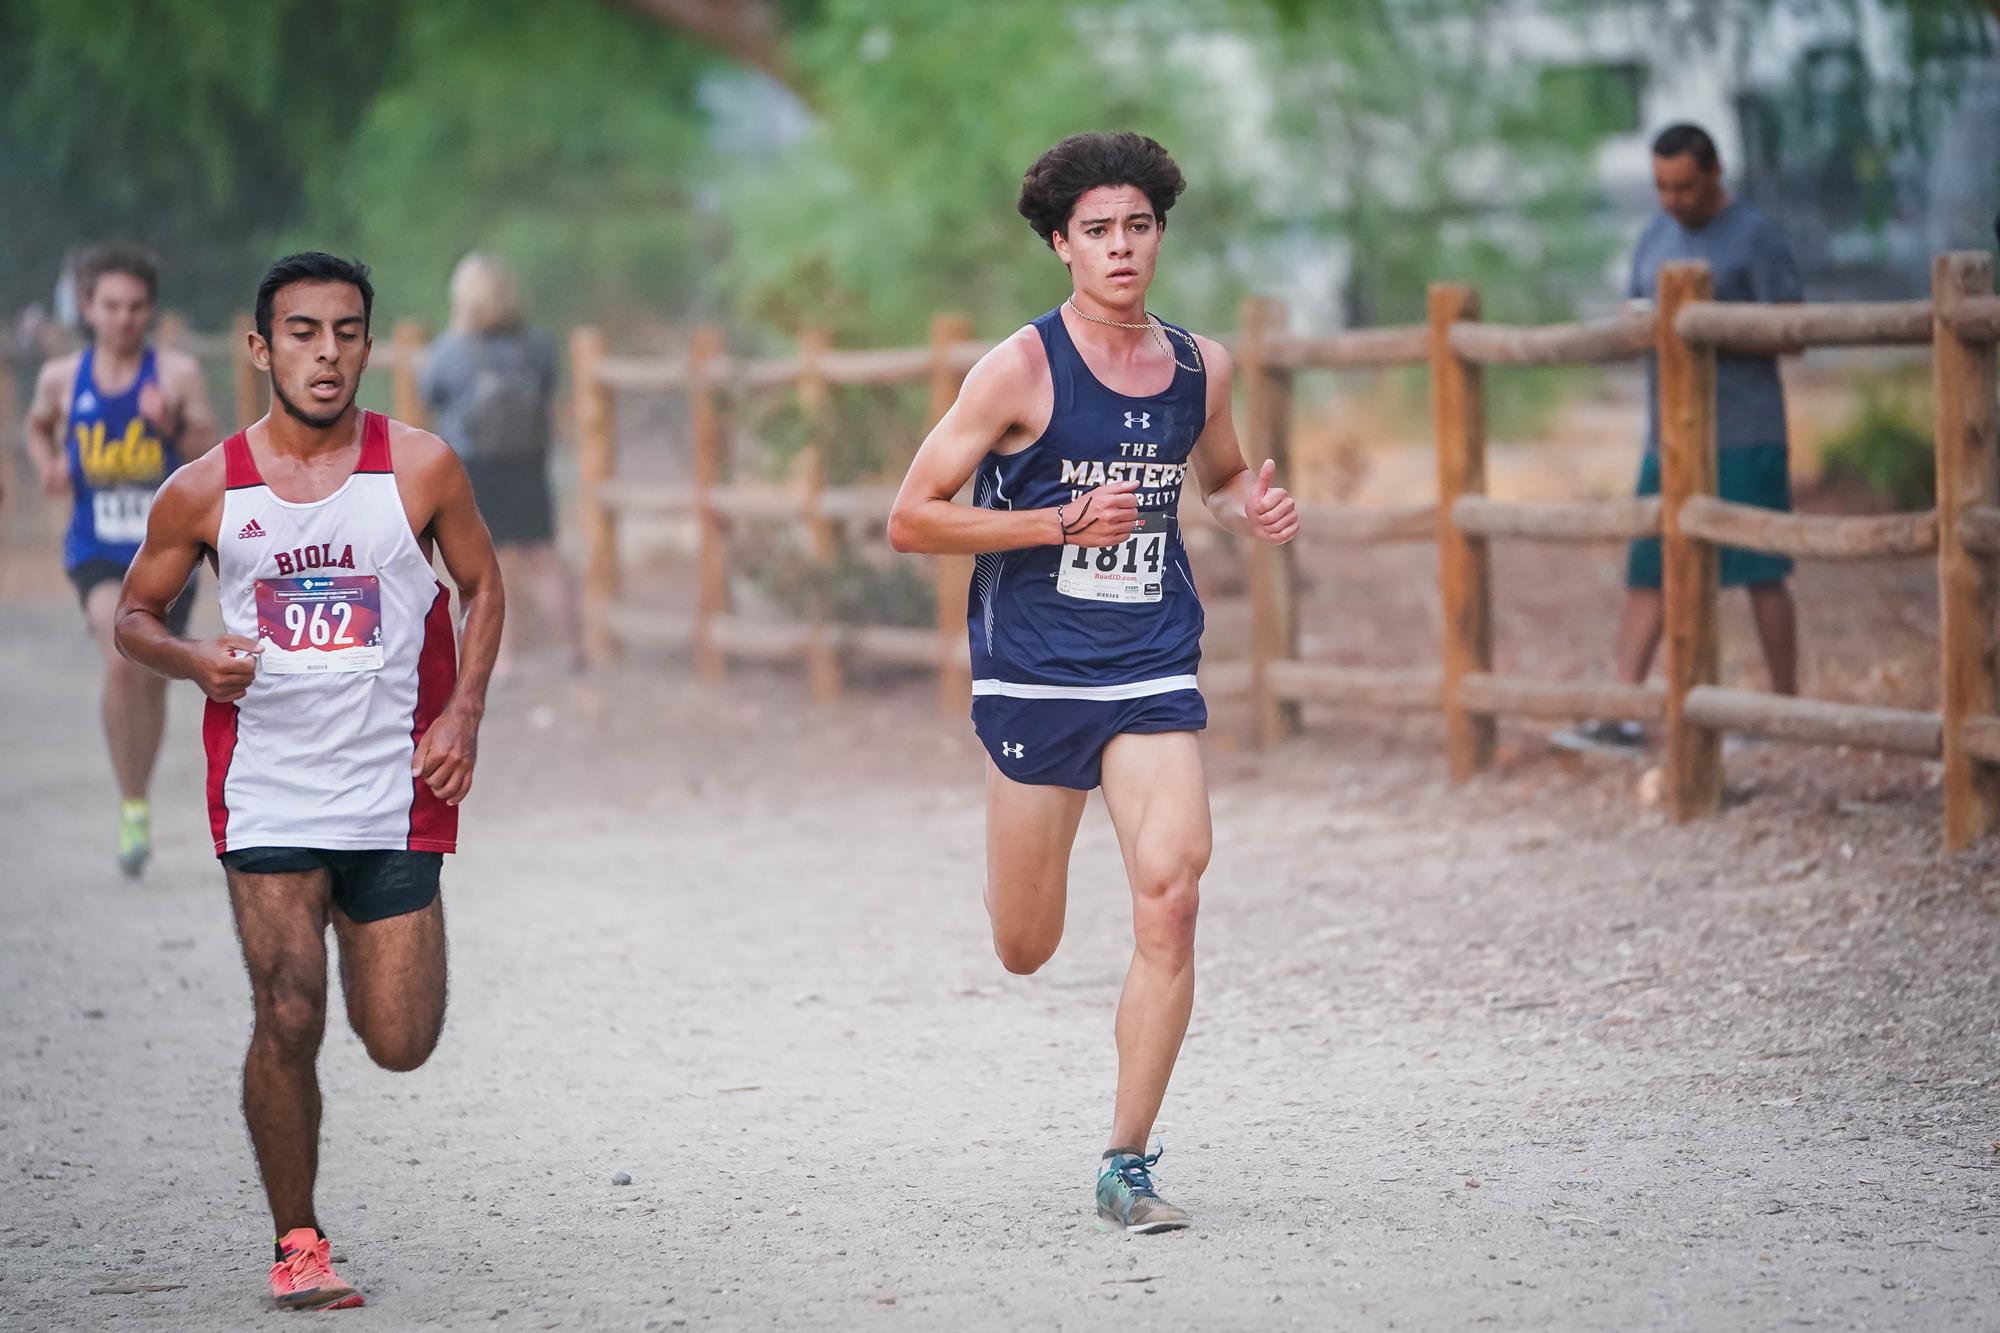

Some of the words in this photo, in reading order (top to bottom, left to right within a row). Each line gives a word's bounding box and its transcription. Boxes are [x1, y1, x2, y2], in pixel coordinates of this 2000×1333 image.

[1120, 442, 1158, 458] THE
[1071, 489, 1176, 507] URSITY
[237, 530, 267, 540] adidas
[273, 543, 356, 576] BIOLA
[1071, 536, 1160, 574] 1814
[284, 601, 355, 647] 962
